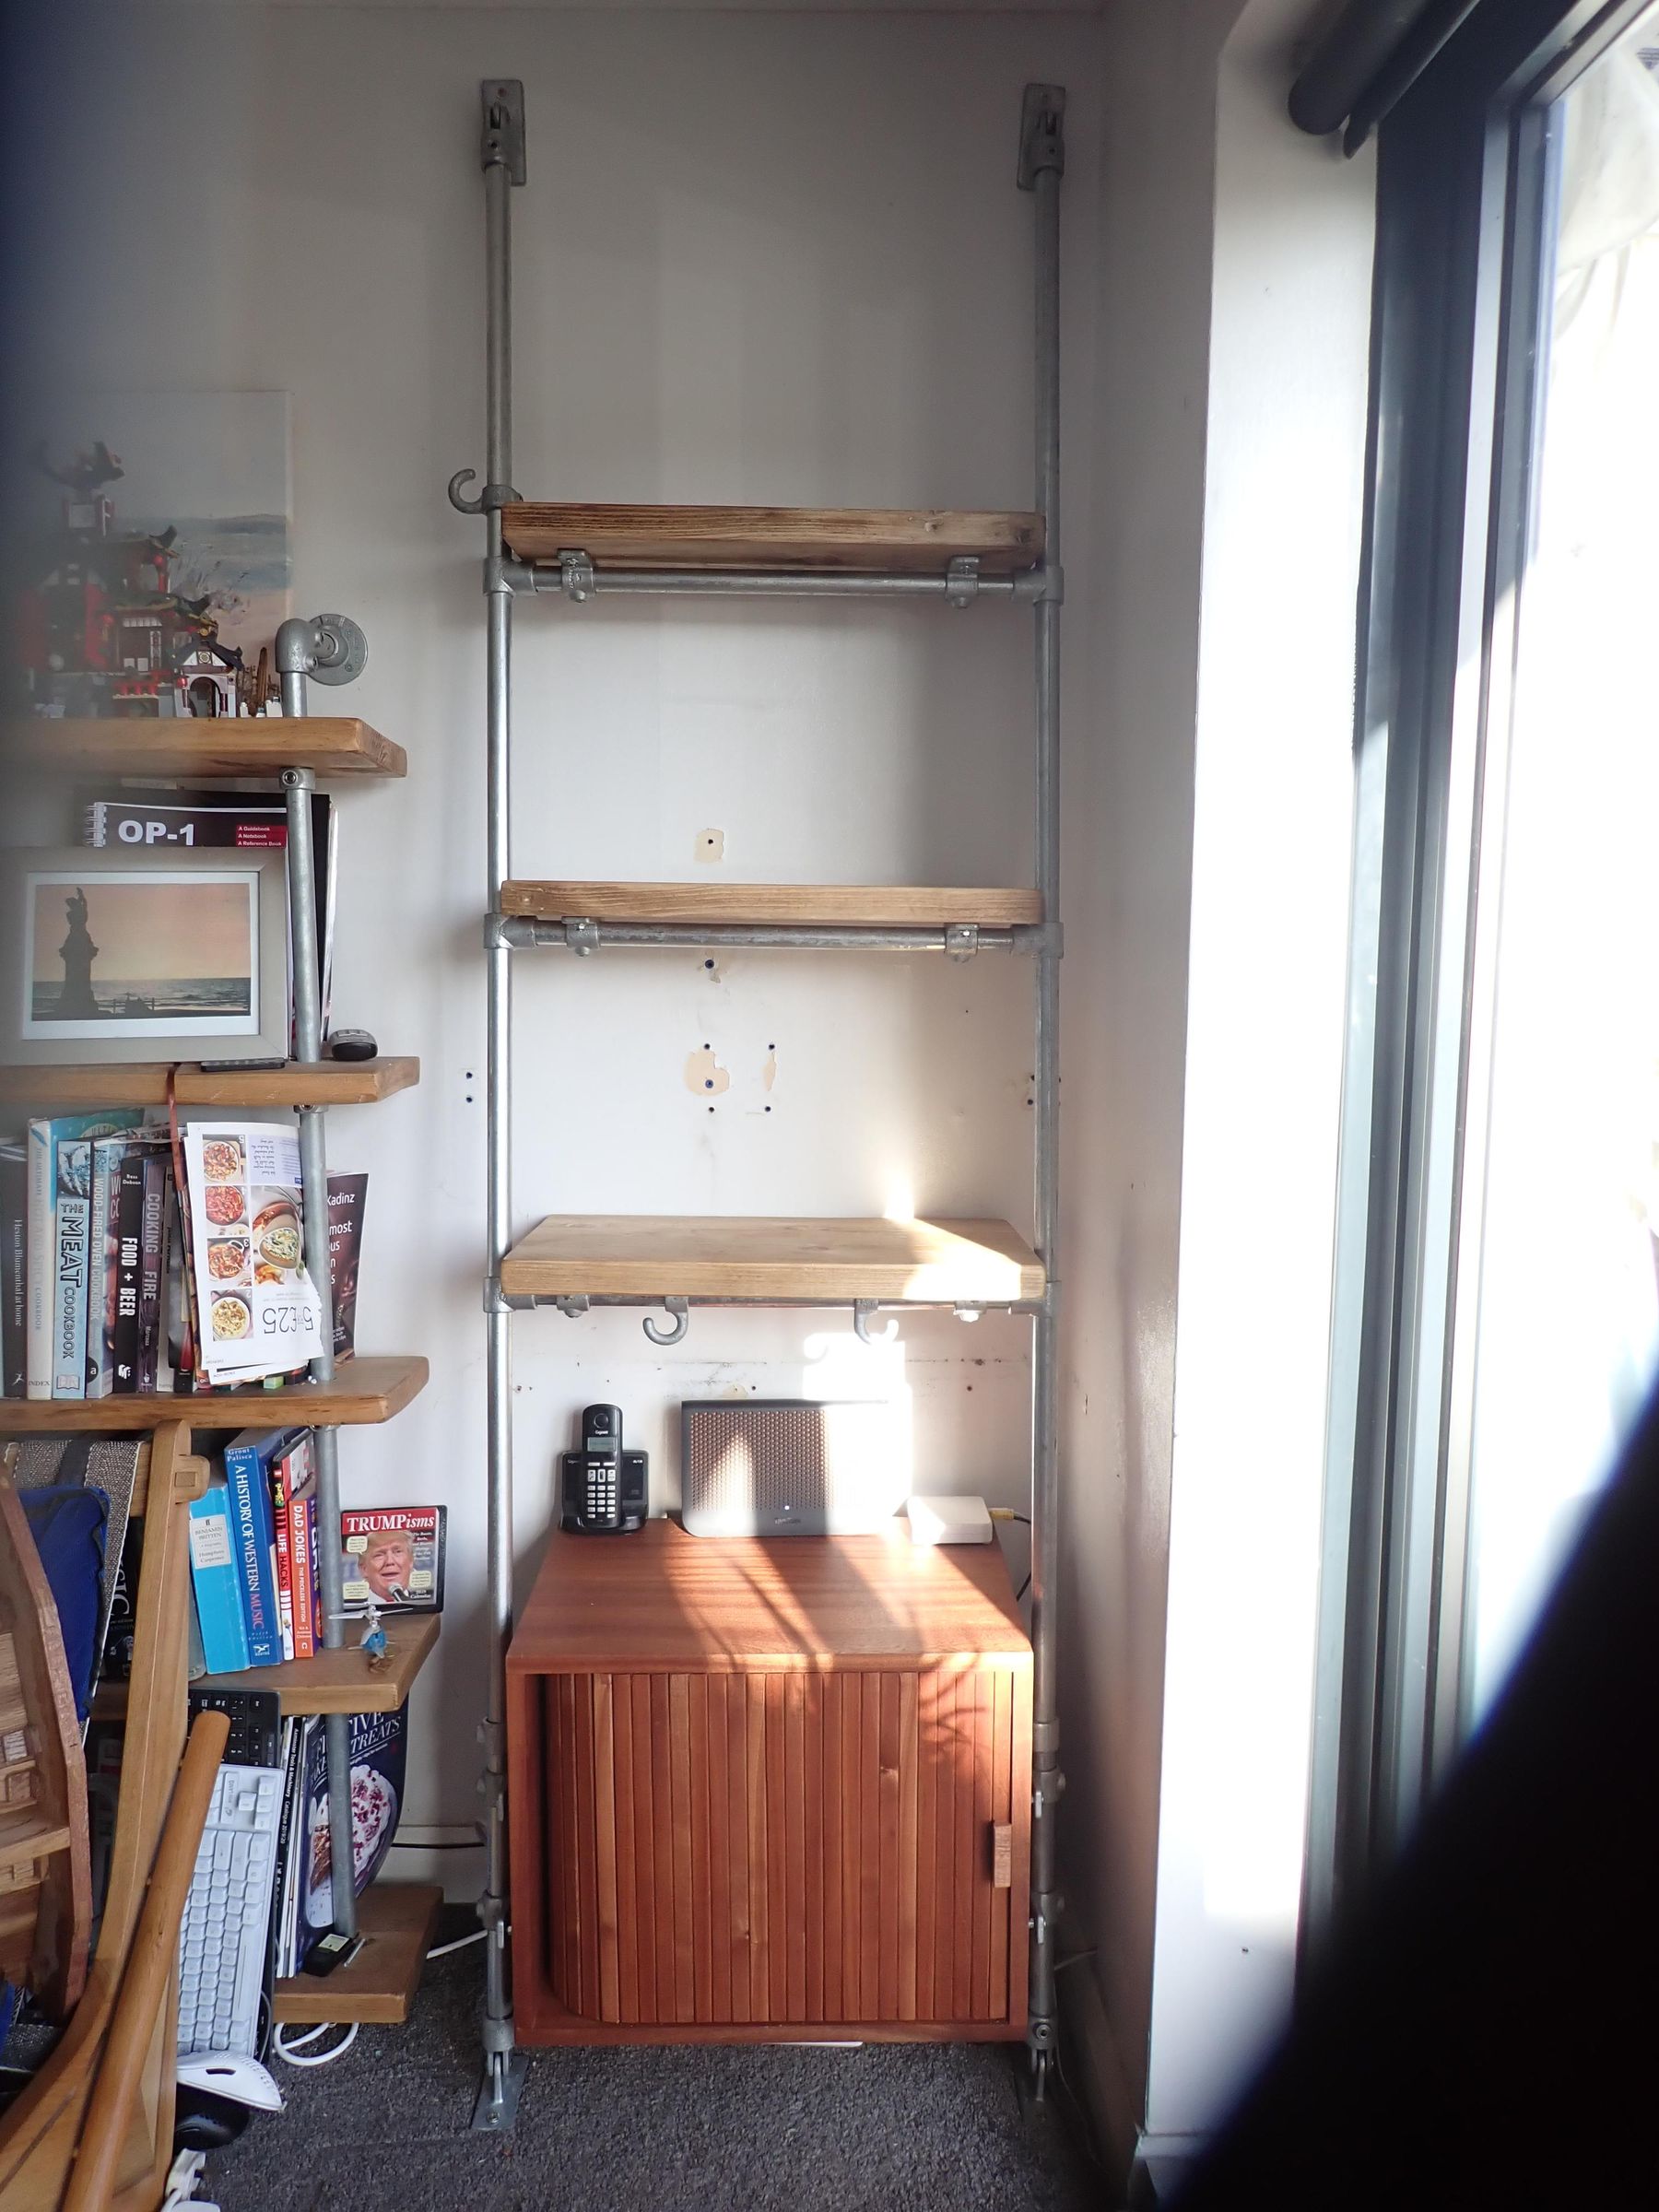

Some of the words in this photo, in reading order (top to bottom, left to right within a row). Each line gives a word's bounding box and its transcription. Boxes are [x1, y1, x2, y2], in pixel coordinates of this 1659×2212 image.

[118, 819, 194, 846] OP-1
[60, 1203, 84, 1214] THE
[92, 1178, 104, 1238] WOOD-FIRED
[14, 1219, 23, 1247] Heston
[146, 1193, 160, 1253] COOKING
[60, 1216, 84, 1288] MEAT
[92, 1241, 102, 1266] OVEN
[121, 1237, 137, 1266] FOOD
[14, 1249, 24, 1295] Blumenthal
[143, 1271, 157, 1300] FIRE
[15, 1296, 24, 1304] at
[90, 1269, 101, 1320] COOKBOOK
[120, 1288, 136, 1316] BEER
[15, 1305, 24, 1326] home
[63, 1287, 76, 1359] COOKBOOK
[235, 1465, 247, 1474] A
[236, 1475, 253, 1524] HISTORY
[293, 1505, 304, 1526] DAD
[347, 1513, 435, 1533] TRUMPisms
[241, 1524, 254, 1538] OF
[277, 1534, 288, 1553] LIFE
[294, 1530, 306, 1564] JOKES
[243, 1538, 260, 1592] WESTERN
[279, 1556, 288, 1588] HACKS
[250, 1593, 265, 1630] MUSIC
[350, 1716, 402, 1754] TREATS
